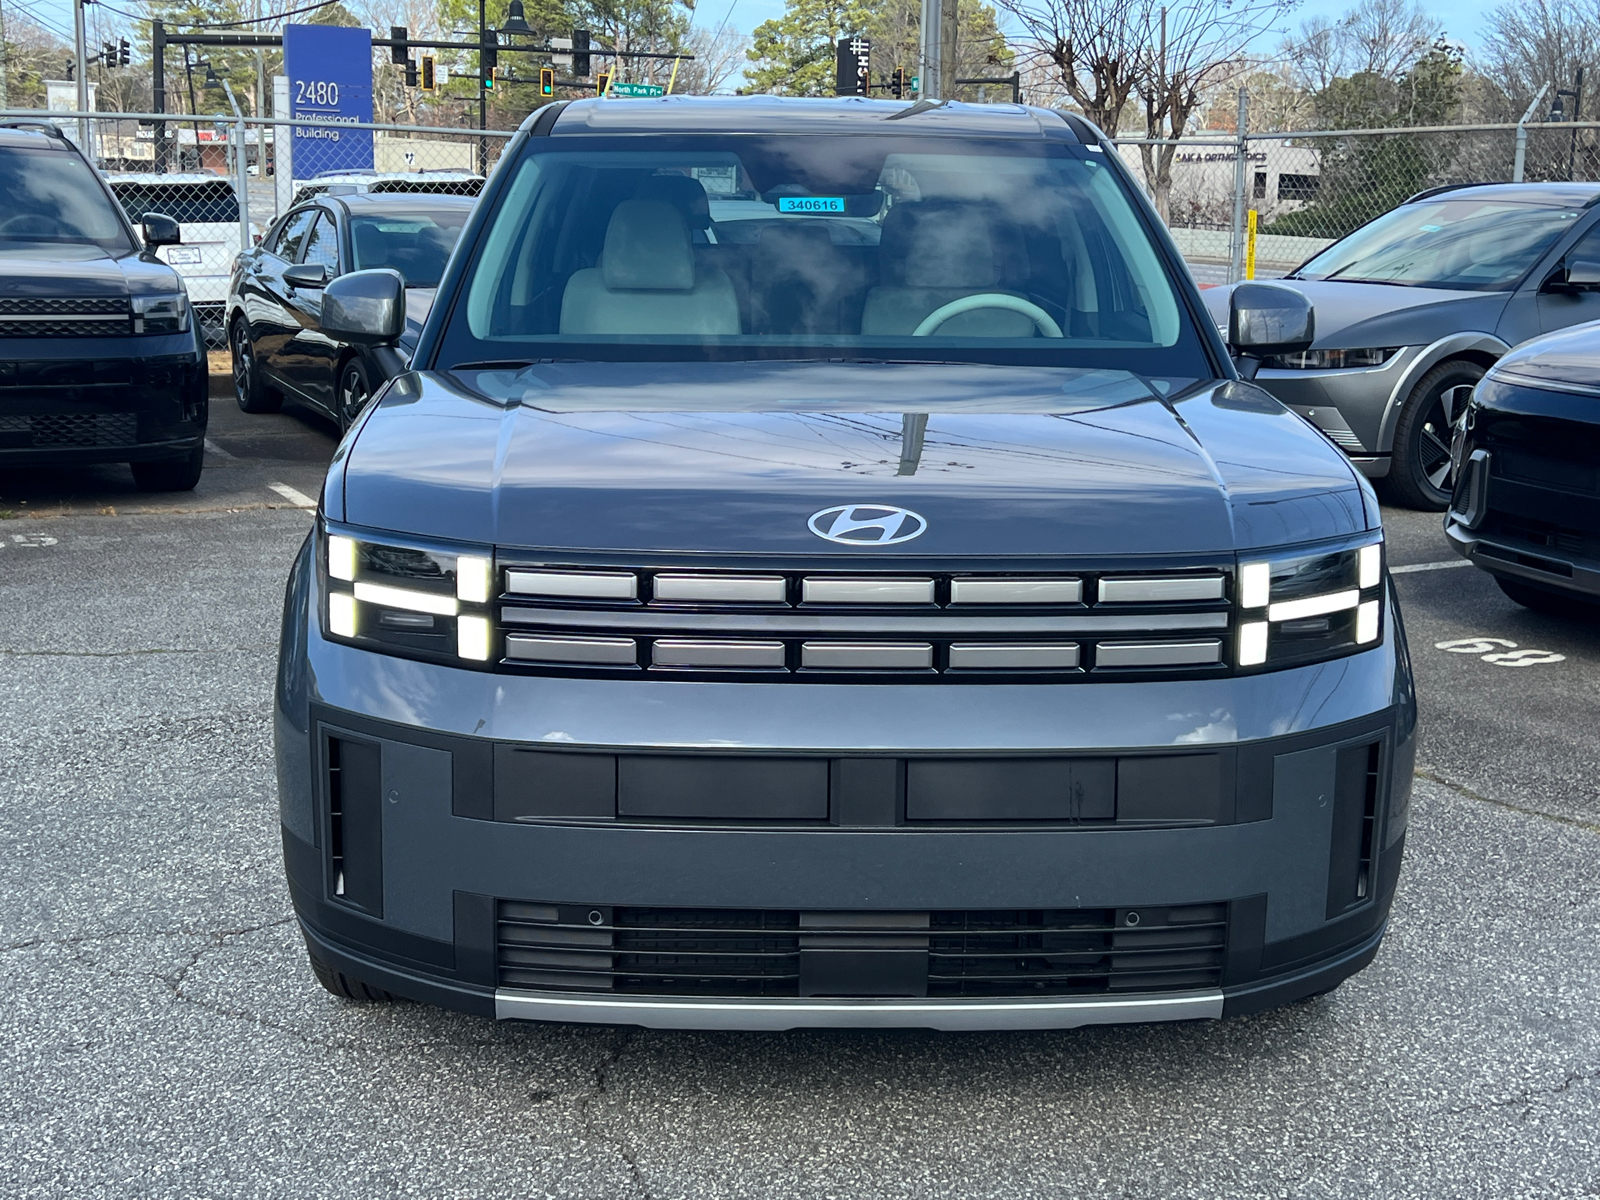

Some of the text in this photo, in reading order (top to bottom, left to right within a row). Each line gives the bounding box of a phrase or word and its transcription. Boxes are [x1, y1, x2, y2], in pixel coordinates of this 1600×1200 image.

[295, 80, 339, 106] 2480
[614, 85, 631, 94] North
[633, 86, 648, 95] Park
[296, 112, 360, 124] Professional
[296, 127, 340, 141] Building
[1204, 152, 1267, 163] ORTHODICS
[788, 201, 838, 210] 340616
